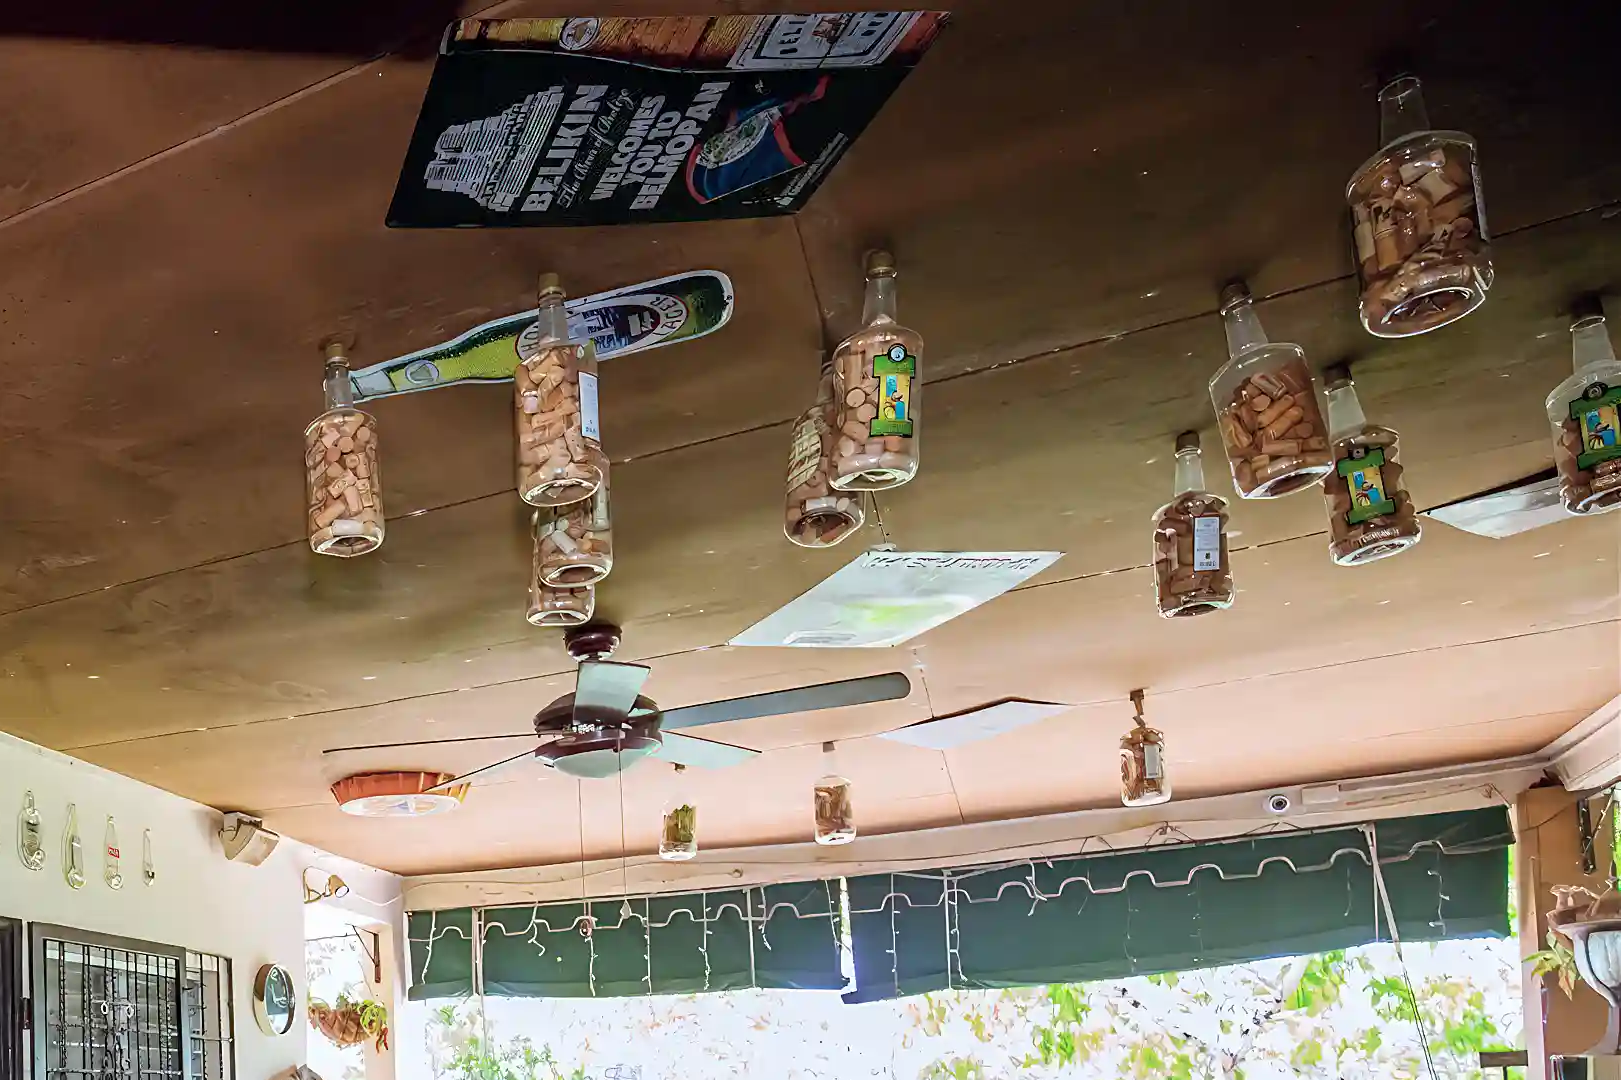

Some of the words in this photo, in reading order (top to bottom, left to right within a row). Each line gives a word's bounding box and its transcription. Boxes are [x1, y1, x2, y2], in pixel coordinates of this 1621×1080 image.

[520, 85, 609, 212] BELIKIN
[589, 95, 666, 200] WELCOMES
[620, 144, 664, 187] YOU
[647, 111, 681, 140] TO
[629, 81, 730, 210] BELMOPAN
[651, 296, 684, 336] LAGER
